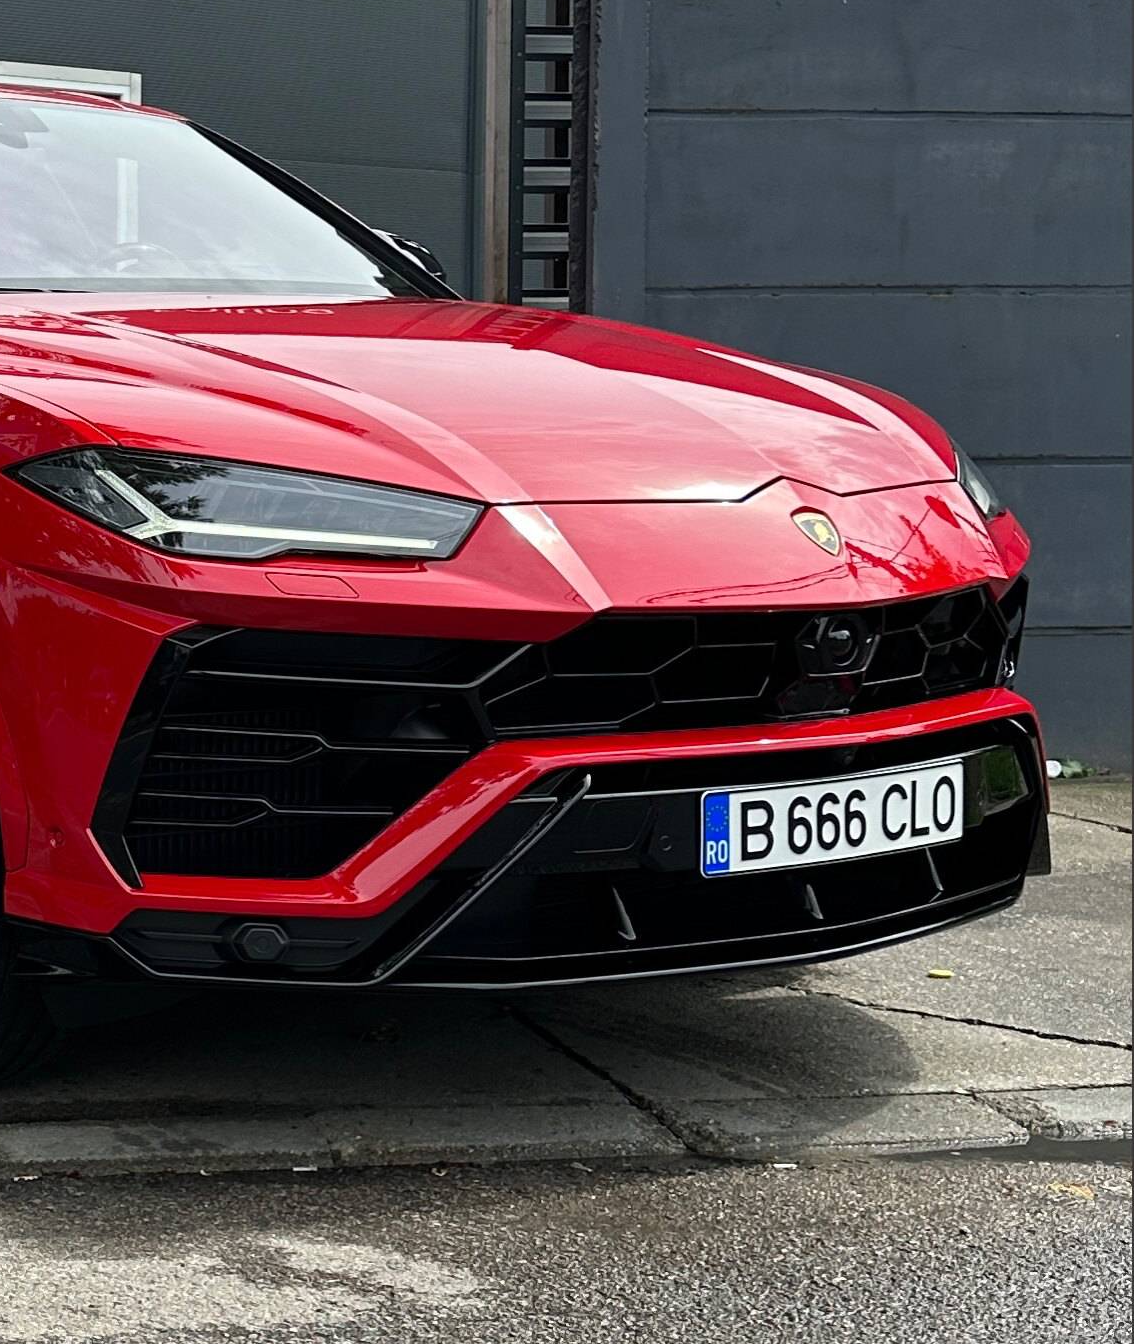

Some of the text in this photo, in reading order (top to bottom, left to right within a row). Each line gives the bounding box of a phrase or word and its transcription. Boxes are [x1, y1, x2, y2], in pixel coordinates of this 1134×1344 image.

[740, 775, 956, 862] B 666 CLO
[706, 839, 729, 865] RO
